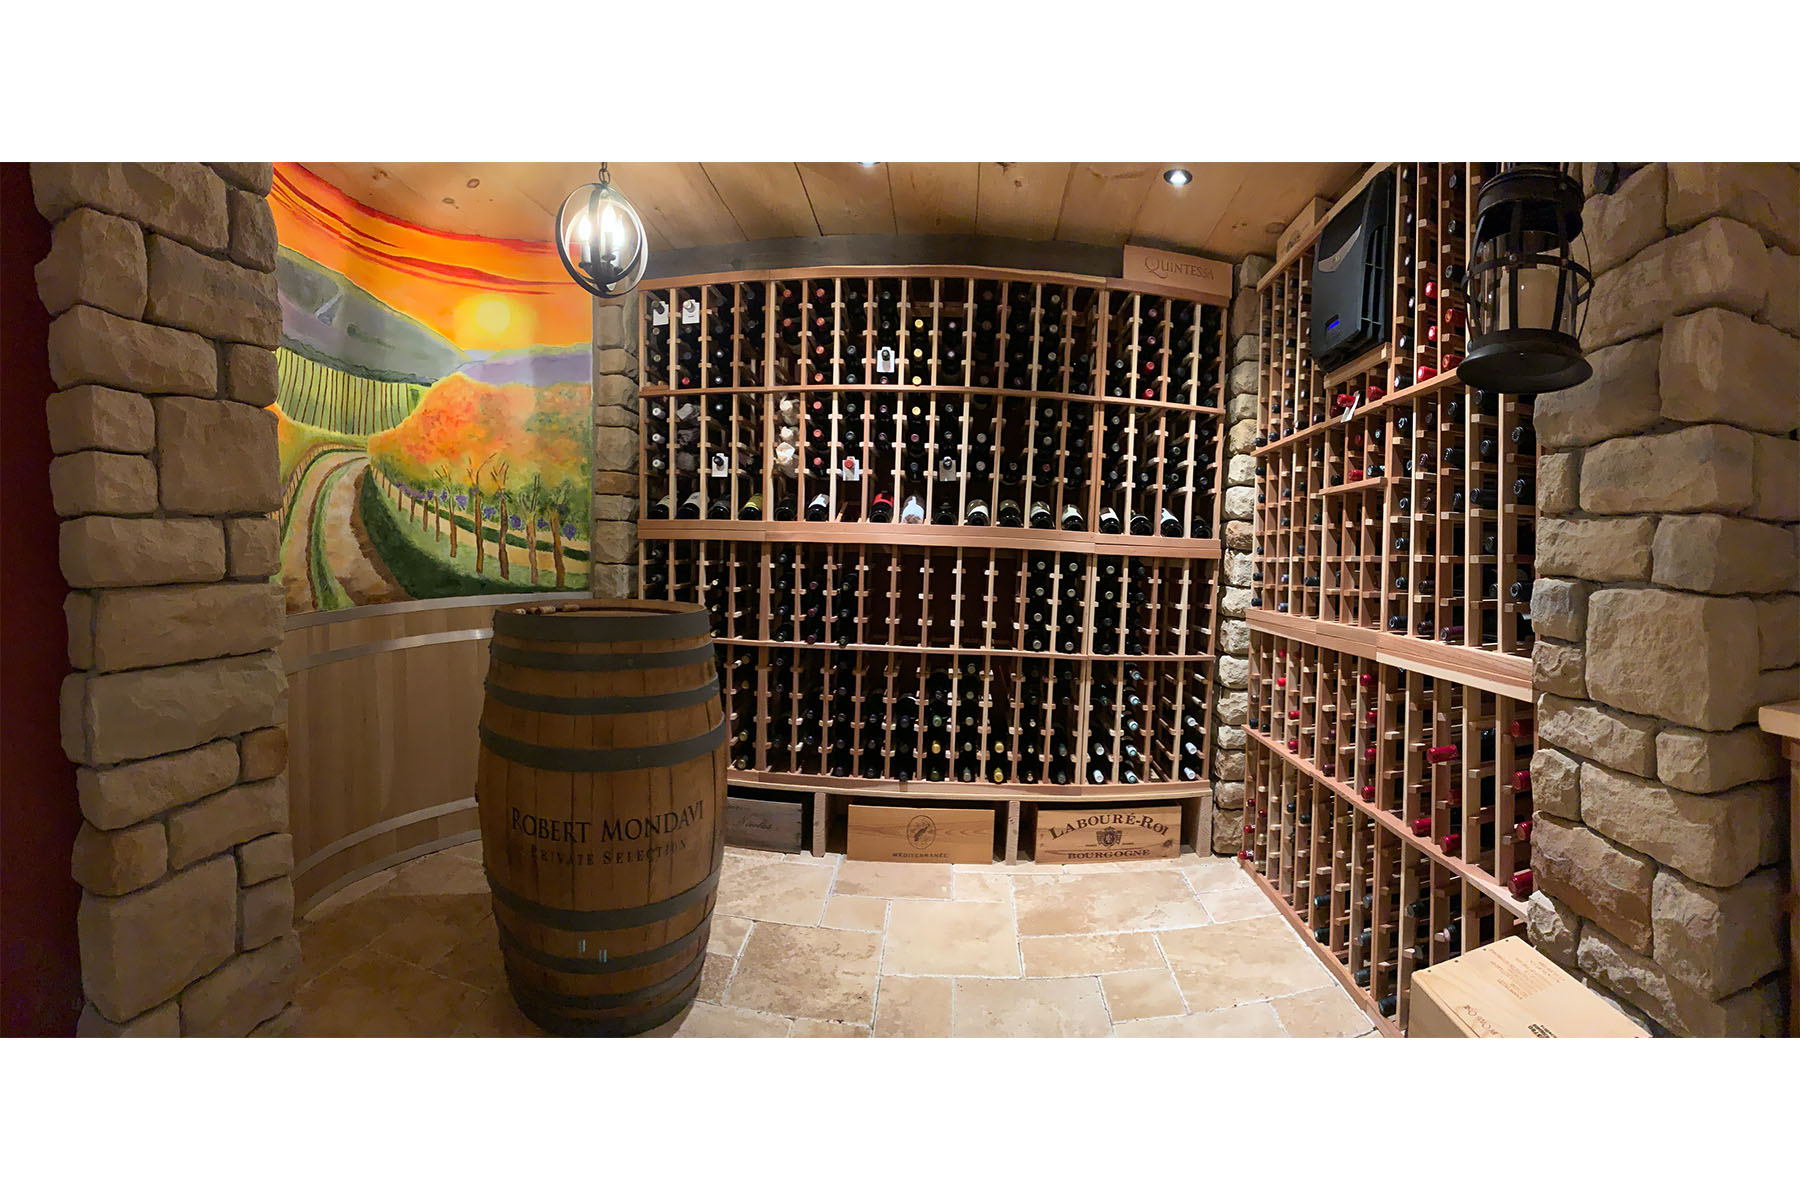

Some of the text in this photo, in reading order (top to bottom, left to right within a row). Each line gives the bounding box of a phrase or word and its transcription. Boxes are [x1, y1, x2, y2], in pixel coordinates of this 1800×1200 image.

[1144, 255, 1215, 281] QUINTESSA
[511, 800, 704, 844] ROBERT MONDAVI
[1048, 812, 1169, 840] LABOURÉ-ROI
[1067, 848, 1151, 860] BOURGOGNE
